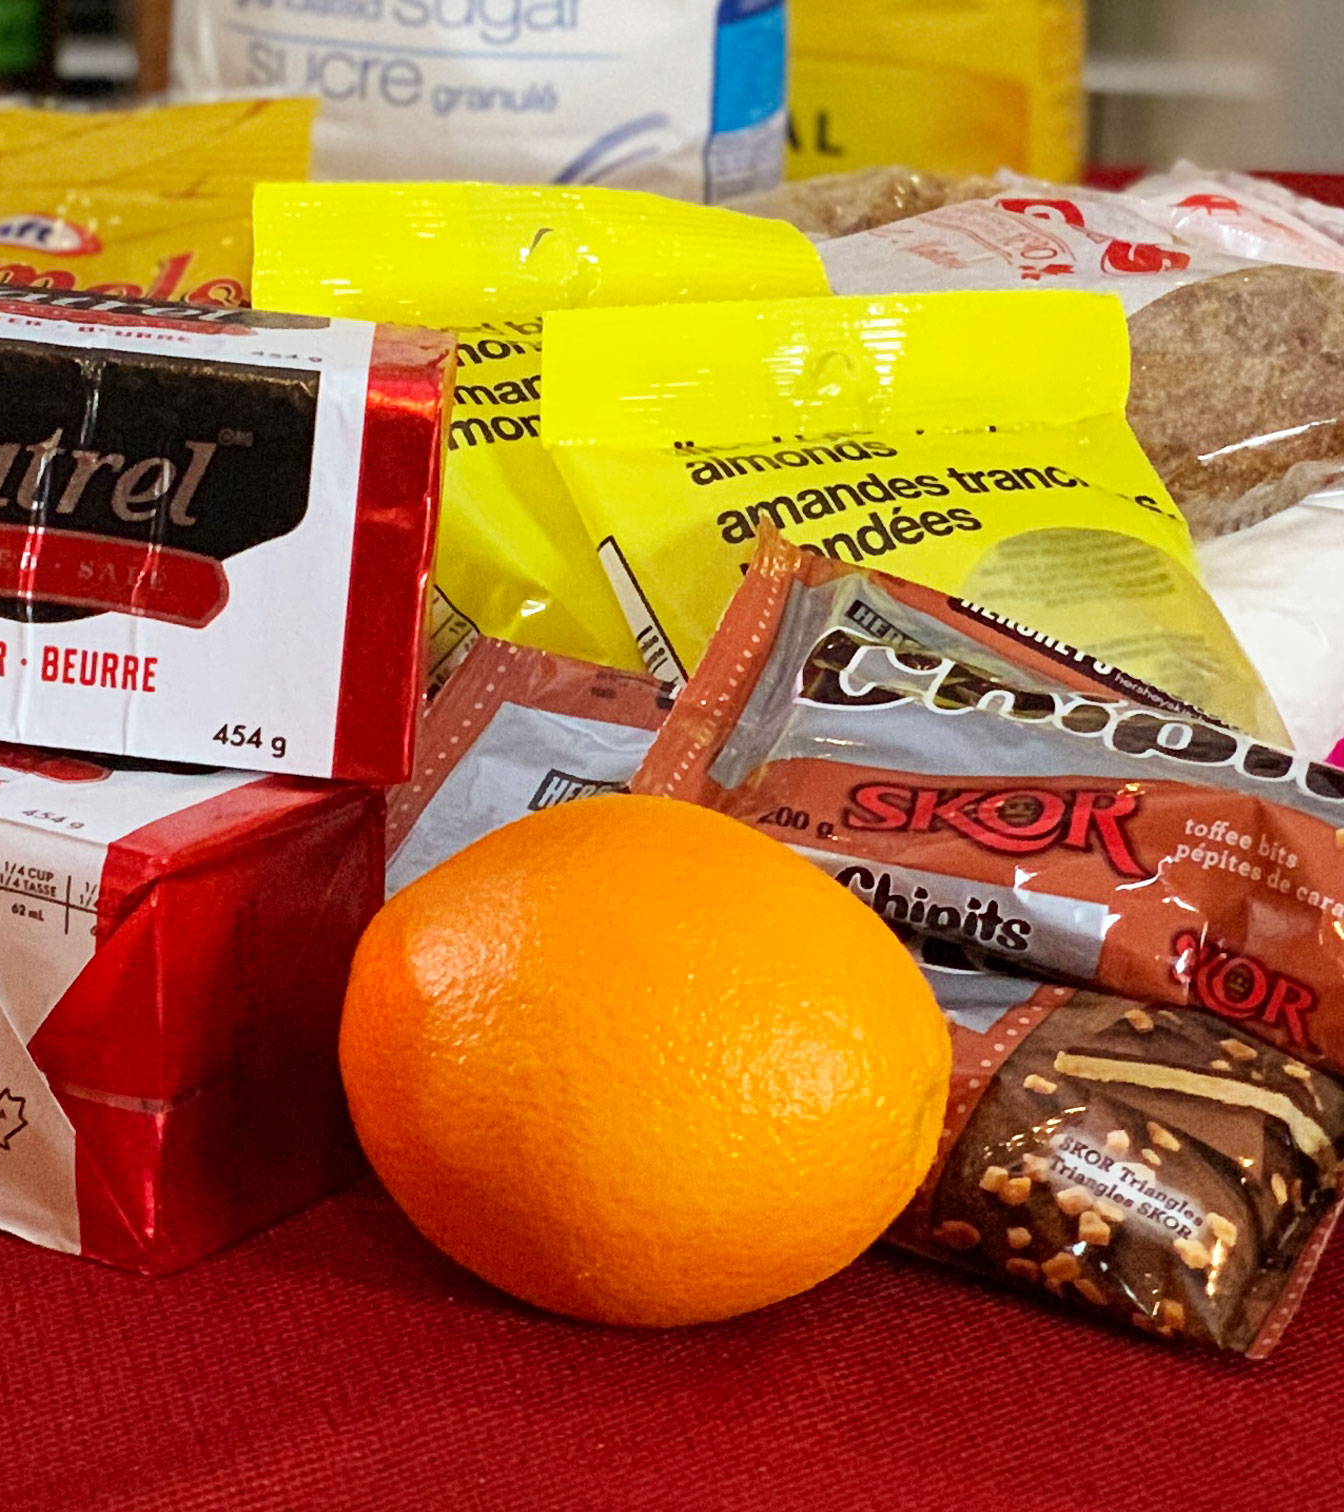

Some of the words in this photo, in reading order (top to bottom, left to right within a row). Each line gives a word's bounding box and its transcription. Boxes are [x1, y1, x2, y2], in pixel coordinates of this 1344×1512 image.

[430, 80, 559, 117] granulé
[685, 437, 899, 486] almonds
[716, 471, 951, 546] amandes
[40, 646, 159, 693] BEURRE
[211, 723, 266, 750] 454
[271, 736, 288, 759] g
[19, 806, 68, 826] 454
[842, 780, 1157, 880] SKOR
[1183, 818, 1254, 852] toffee
[1257, 827, 1299, 869] bits
[0, 872, 21, 888] 1/4
[23, 879, 57, 898] TASSE
[4, 861, 26, 876] 1/4
[27, 867, 55, 883] CUP
[1174, 840, 1263, 883] pépites
[1265, 867, 1293, 895] de
[1295, 885, 1344, 920] cara
[11, 903, 27, 916] 62
[1048, 1154, 1135, 1208] Triangles
[1136, 1201, 1194, 1241] SKOR
[1057, 1135, 1115, 1174] SKOR
[1118, 1166, 1204, 1228] Triangles
